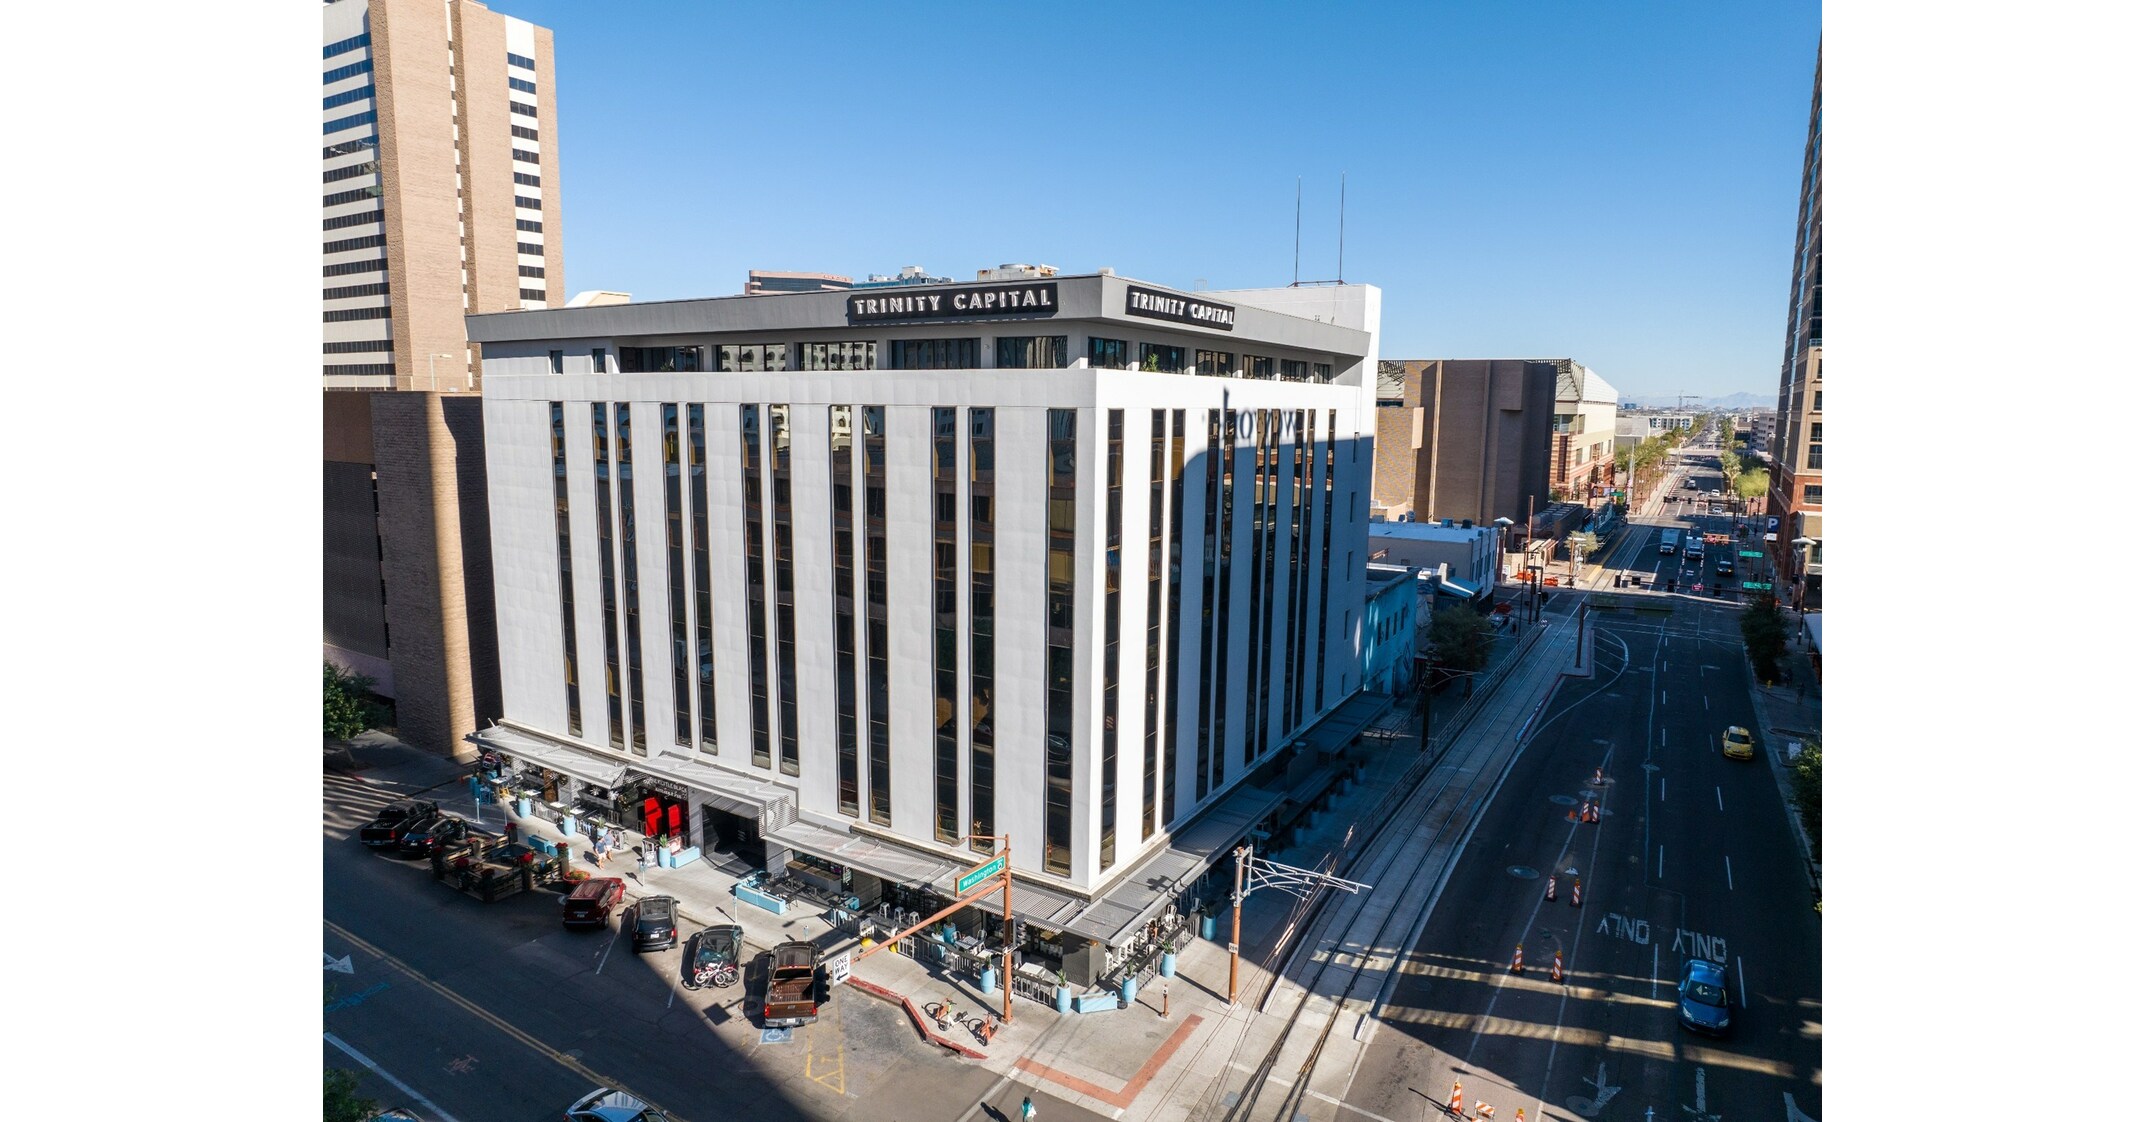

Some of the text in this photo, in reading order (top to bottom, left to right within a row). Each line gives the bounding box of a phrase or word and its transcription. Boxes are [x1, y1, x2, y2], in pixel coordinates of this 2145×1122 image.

[854, 289, 1051, 315] TRINITY CAPITAL
[1131, 291, 1233, 325] TRINITY CAPITAL
[1768, 518, 1778, 528] P
[962, 864, 997, 888] Washington
[1596, 912, 1650, 945] ONLY
[1671, 927, 1728, 963] ONLY
[834, 954, 848, 968] ONE
[834, 963, 848, 975] WAY
